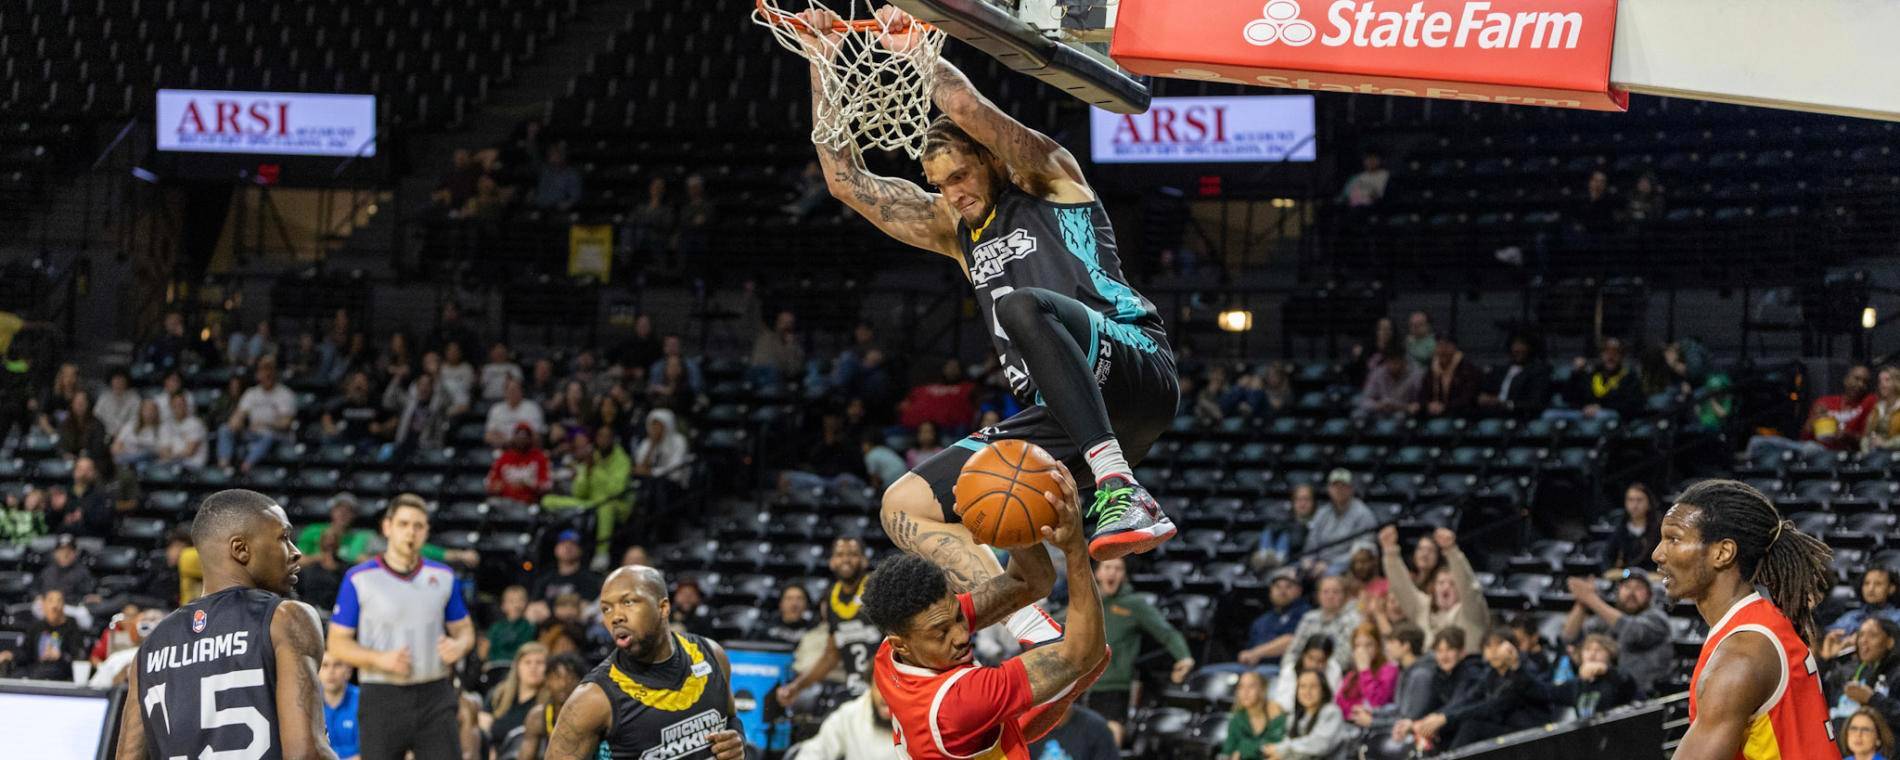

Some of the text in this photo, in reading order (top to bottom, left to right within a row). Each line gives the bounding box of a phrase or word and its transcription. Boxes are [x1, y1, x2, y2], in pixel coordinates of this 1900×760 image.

[177, 99, 290, 136] ARSI
[1113, 106, 1231, 144] ARSI
[146, 631, 249, 673] WILLIAMS
[665, 711, 719, 743] WICHITA
